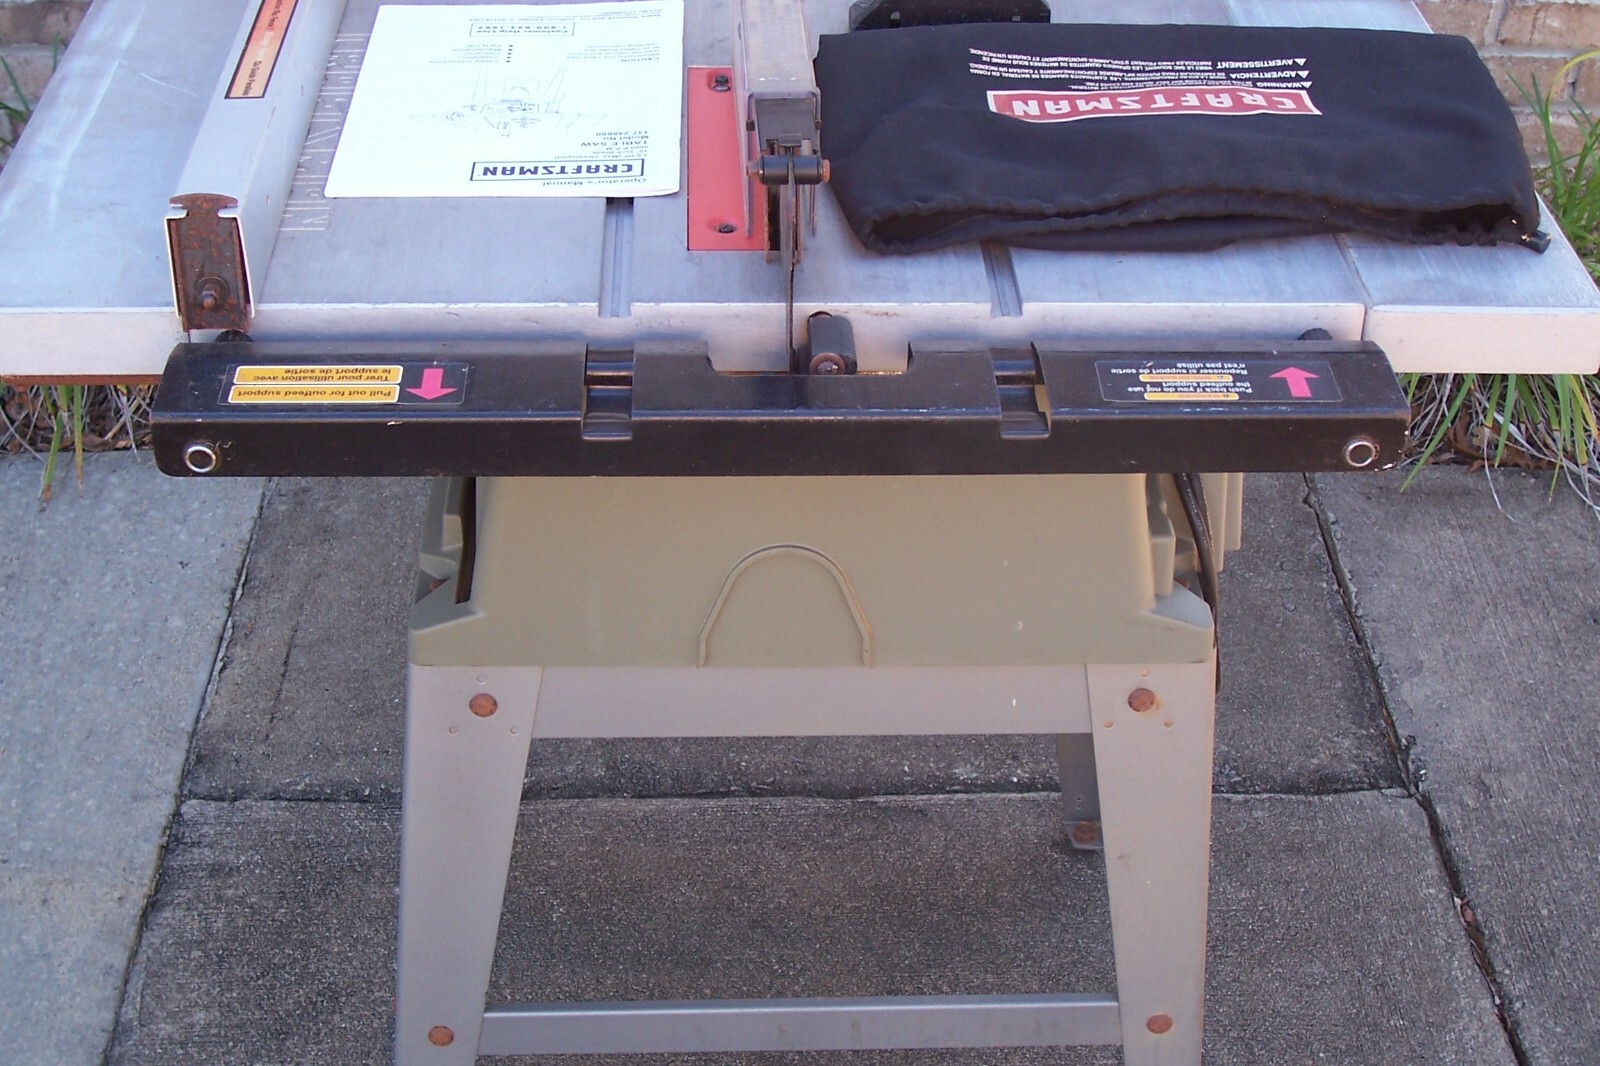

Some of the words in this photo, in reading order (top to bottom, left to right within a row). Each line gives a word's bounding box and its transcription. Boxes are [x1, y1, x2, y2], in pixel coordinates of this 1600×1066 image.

[1216, 59, 1294, 68] AVERTISSEMENT
[1012, 92, 1296, 116] CRAFTSMAN
[482, 164, 632, 176] CRAFTSMAN
